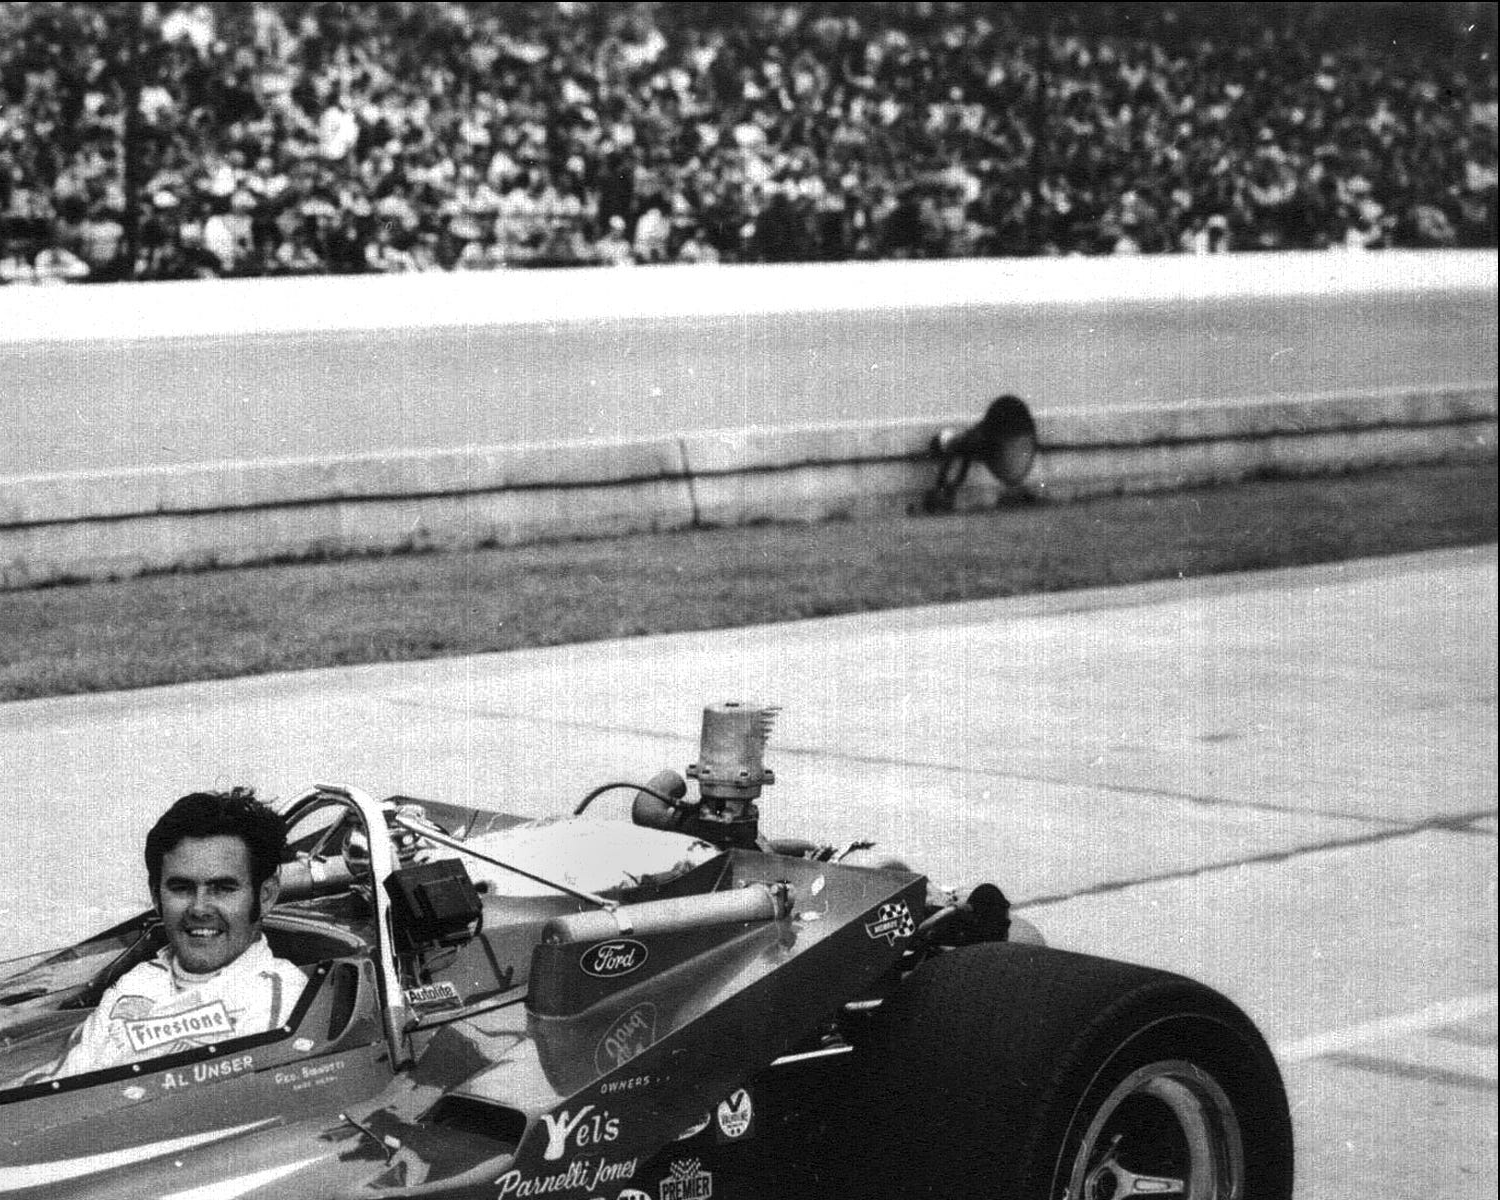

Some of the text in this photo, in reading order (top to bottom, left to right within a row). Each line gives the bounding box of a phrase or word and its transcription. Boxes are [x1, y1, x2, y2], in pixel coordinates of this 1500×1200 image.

[594, 944, 636, 972] Ford
[131, 1012, 223, 1045] Firestone
[161, 1054, 255, 1090] AL UNSER
[585, 1157, 638, 1192] Jones
